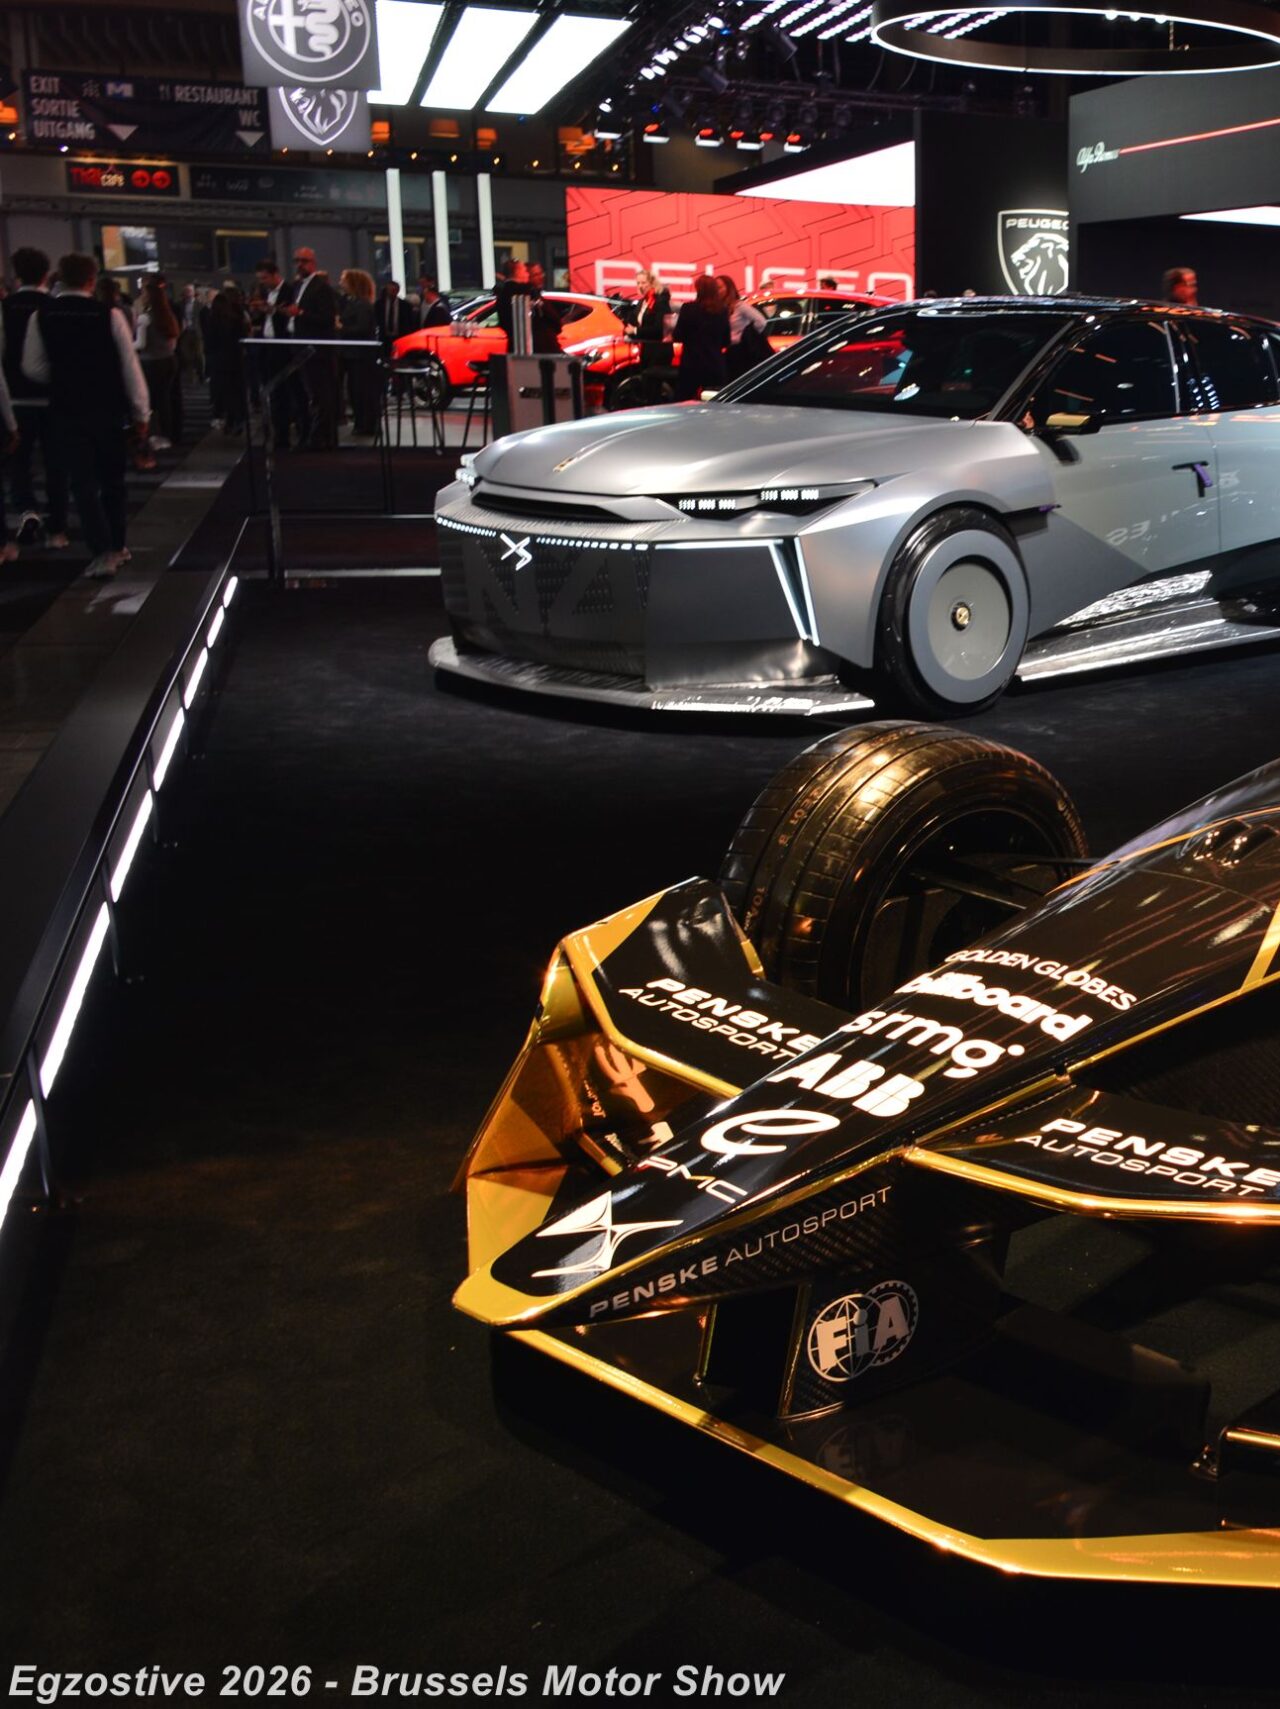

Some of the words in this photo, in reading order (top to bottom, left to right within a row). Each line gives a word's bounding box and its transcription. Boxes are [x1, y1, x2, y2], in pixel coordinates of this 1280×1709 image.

[30, 76, 60, 95] EXIT
[32, 99, 81, 118] SORTIE
[173, 86, 260, 105] RESTAURANT
[33, 120, 95, 140] UITGANG
[239, 111, 261, 127] WC
[945, 949, 1039, 972] GOLDEN
[1035, 959, 1138, 1012] GLOBES
[618, 988, 798, 1060] AUTOSPORT
[646, 978, 822, 1053] PENSKE
[767, 1053, 926, 1117] ABB
[637, 1155, 748, 1203] PMC
[1014, 1135, 1265, 1196] AUTOSPORT
[589, 1257, 719, 1319] PENSKE
[724, 1185, 892, 1269] AUTOSPORT
